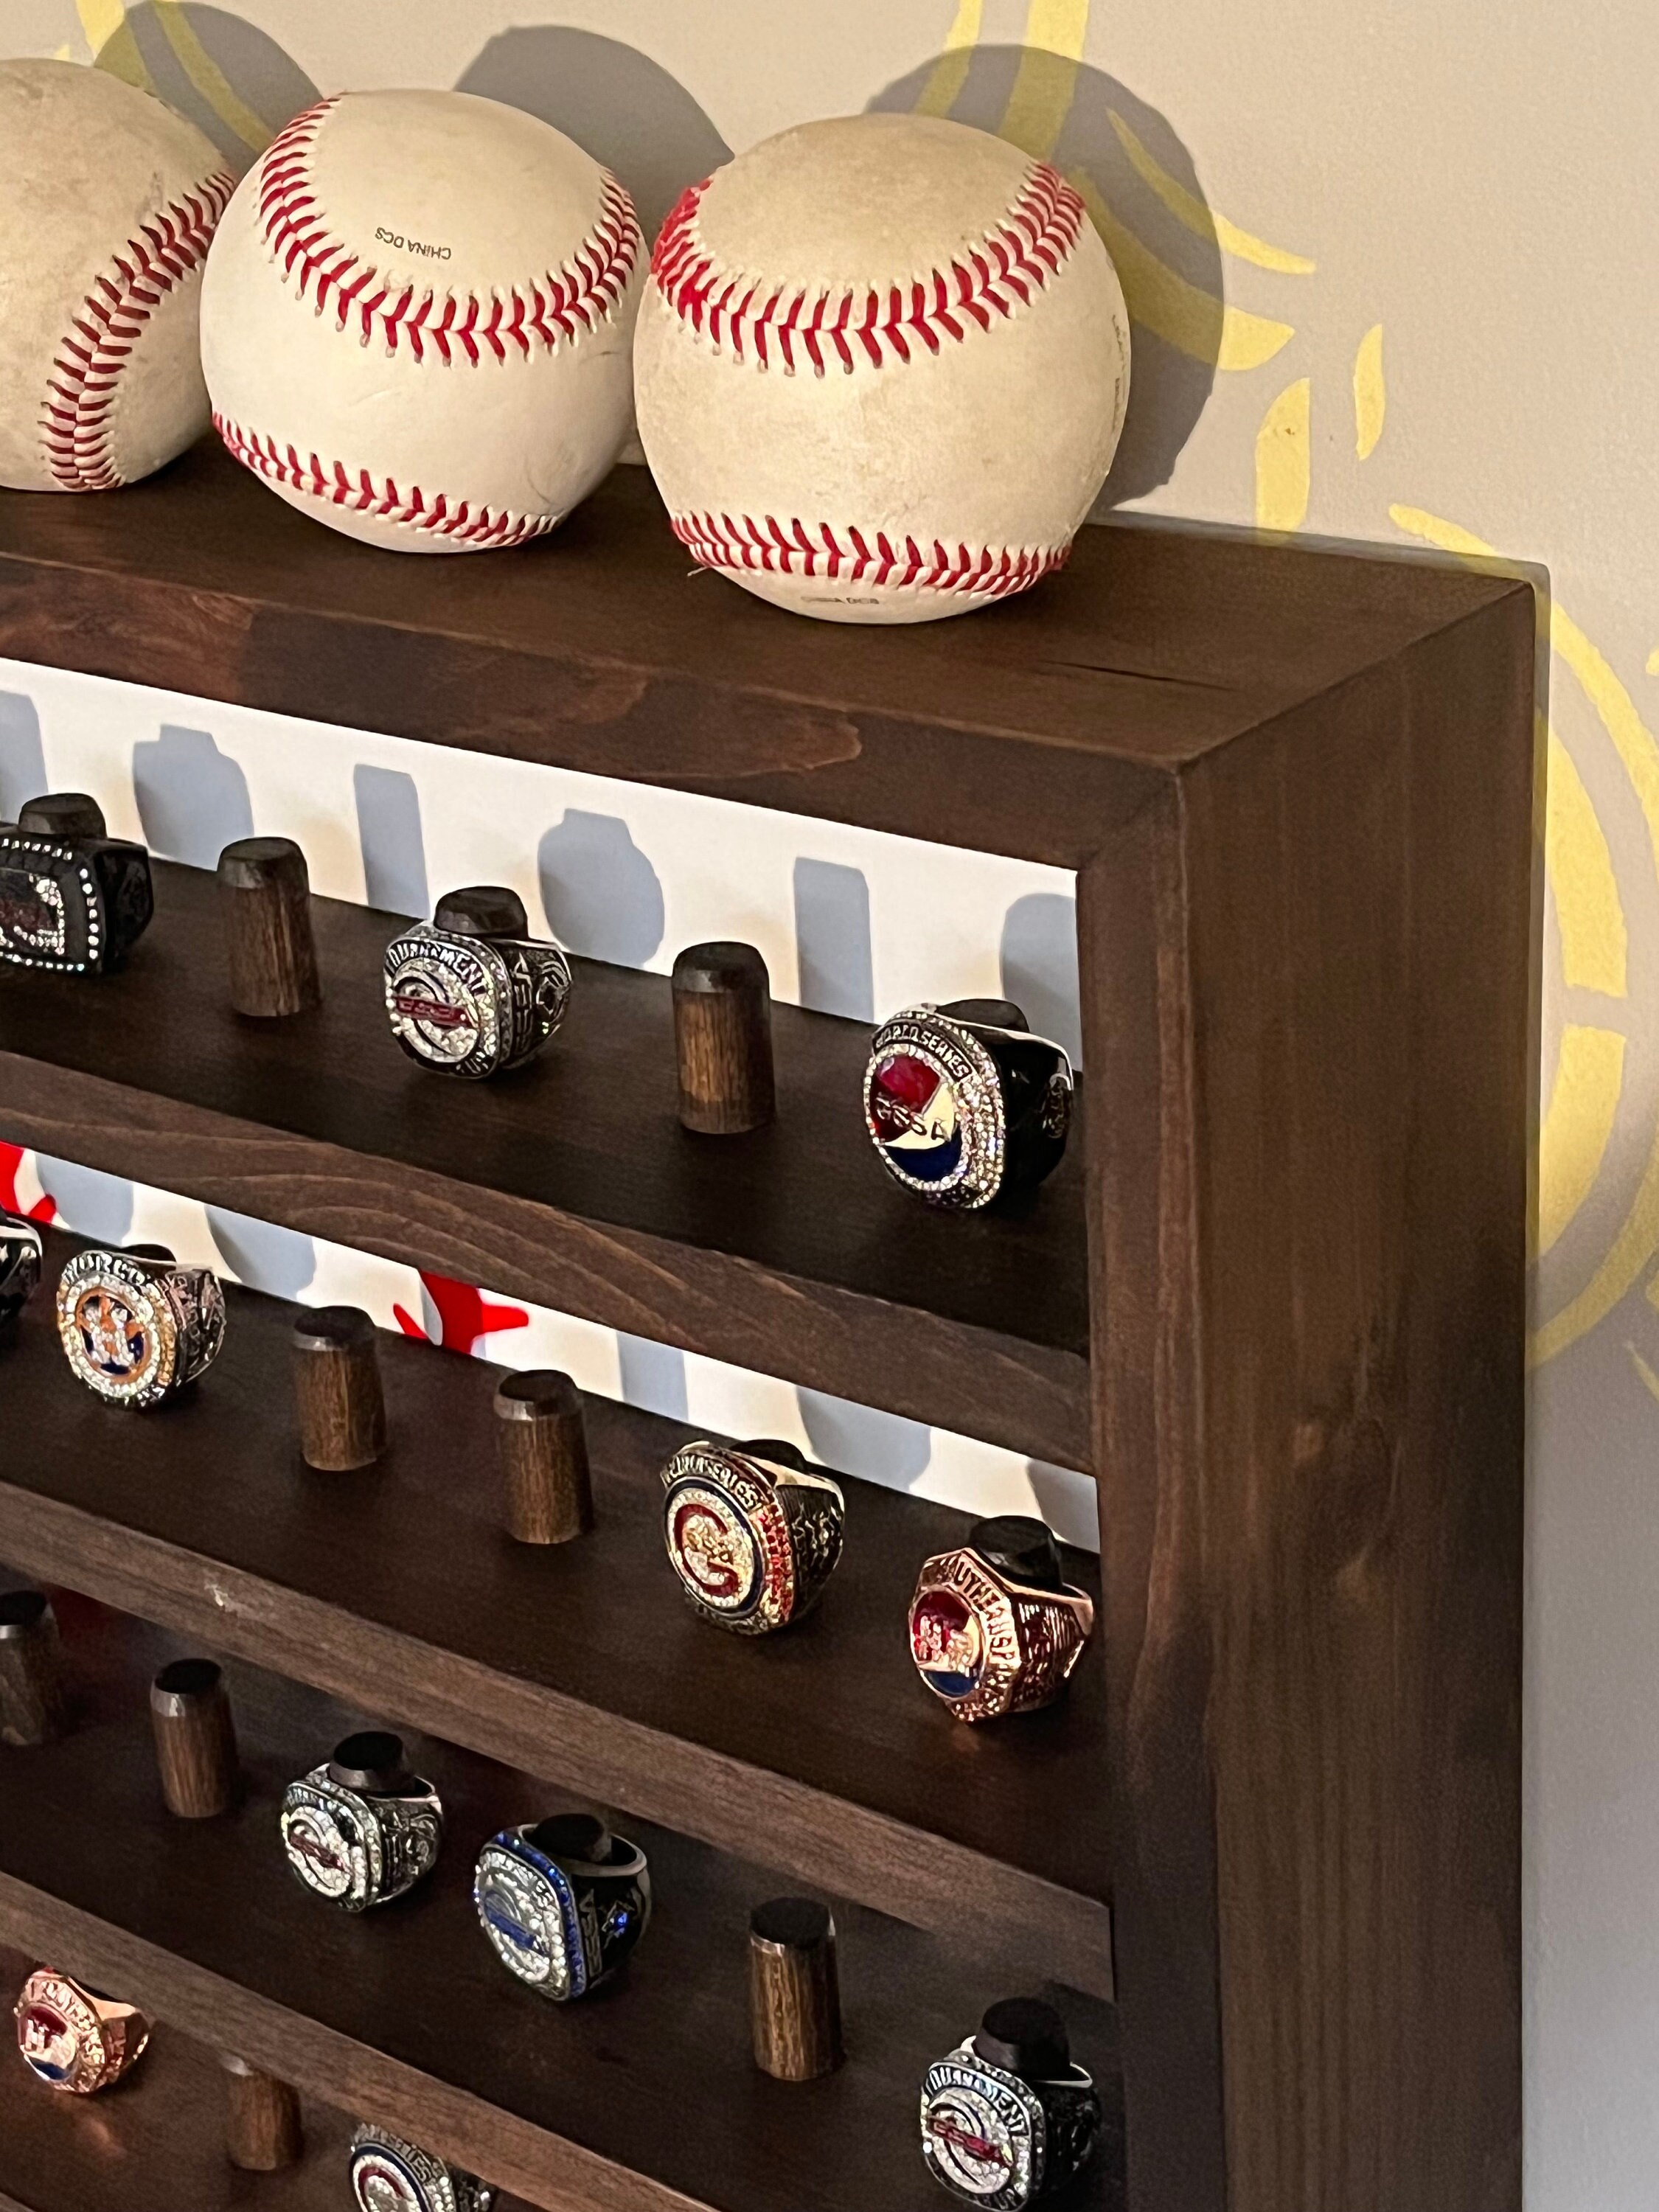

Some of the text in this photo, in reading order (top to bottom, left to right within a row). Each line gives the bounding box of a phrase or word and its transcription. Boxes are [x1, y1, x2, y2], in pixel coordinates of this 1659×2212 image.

[375, 226, 452, 260] CHINA DCS
[875, 1023, 970, 1077] WORLD SERIES
